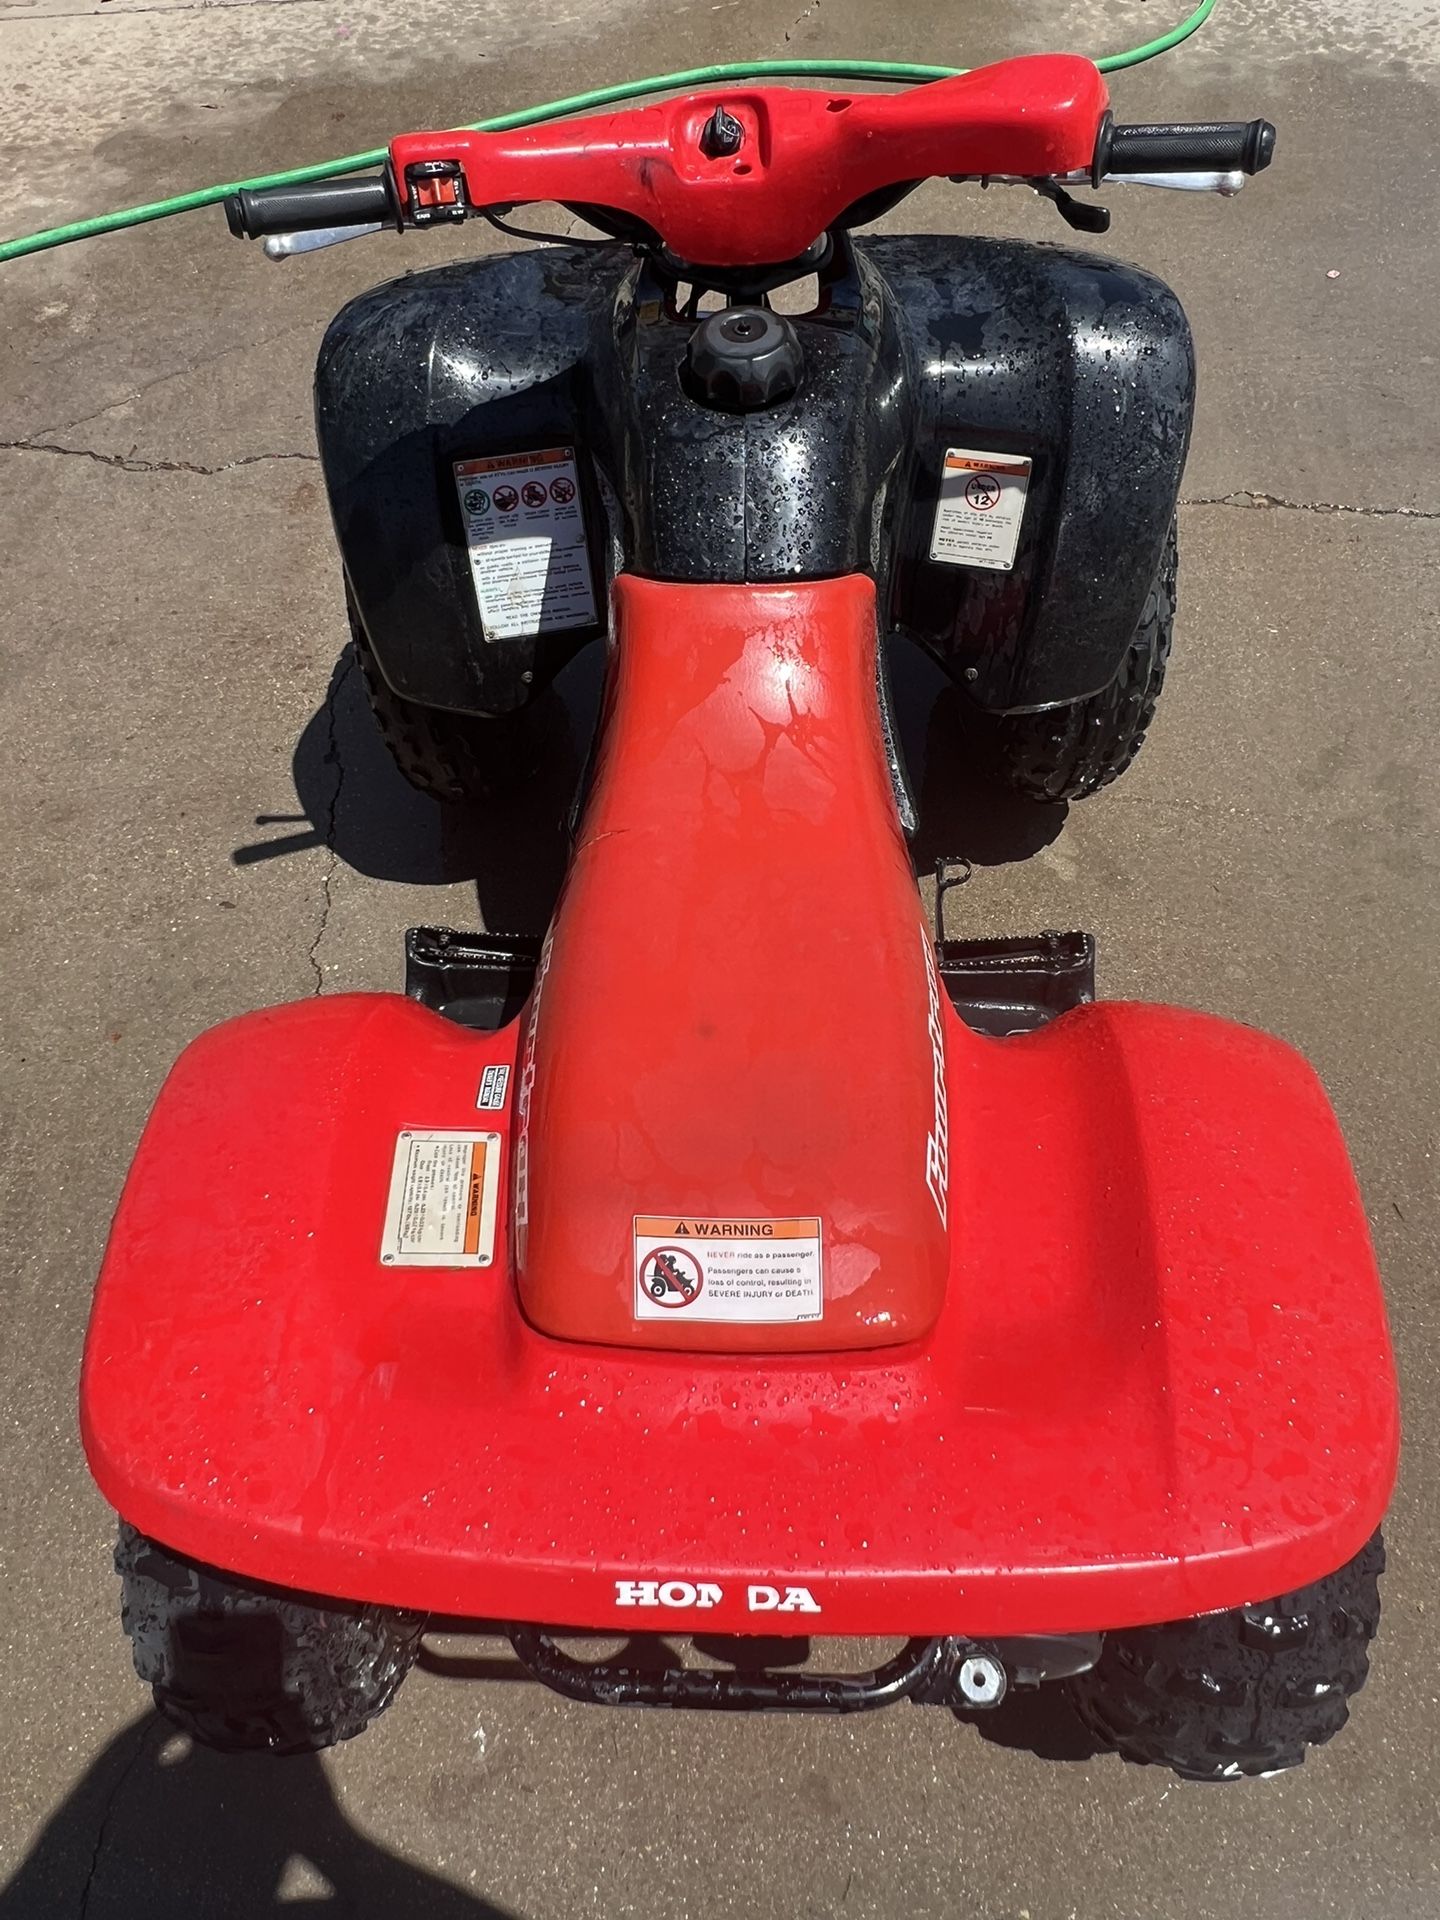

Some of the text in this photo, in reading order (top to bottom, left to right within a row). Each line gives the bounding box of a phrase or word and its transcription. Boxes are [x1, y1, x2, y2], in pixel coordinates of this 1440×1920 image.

[974, 495, 989, 505] 12
[470, 1183, 480, 1216] WARNING
[694, 1224, 774, 1236] WARNING
[737, 1251, 752, 1259] ride
[707, 1267, 753, 1276] Passengers
[736, 1279, 767, 1287] control,
[768, 1279, 802, 1287] resulting
[743, 1290, 772, 1298] INJURY
